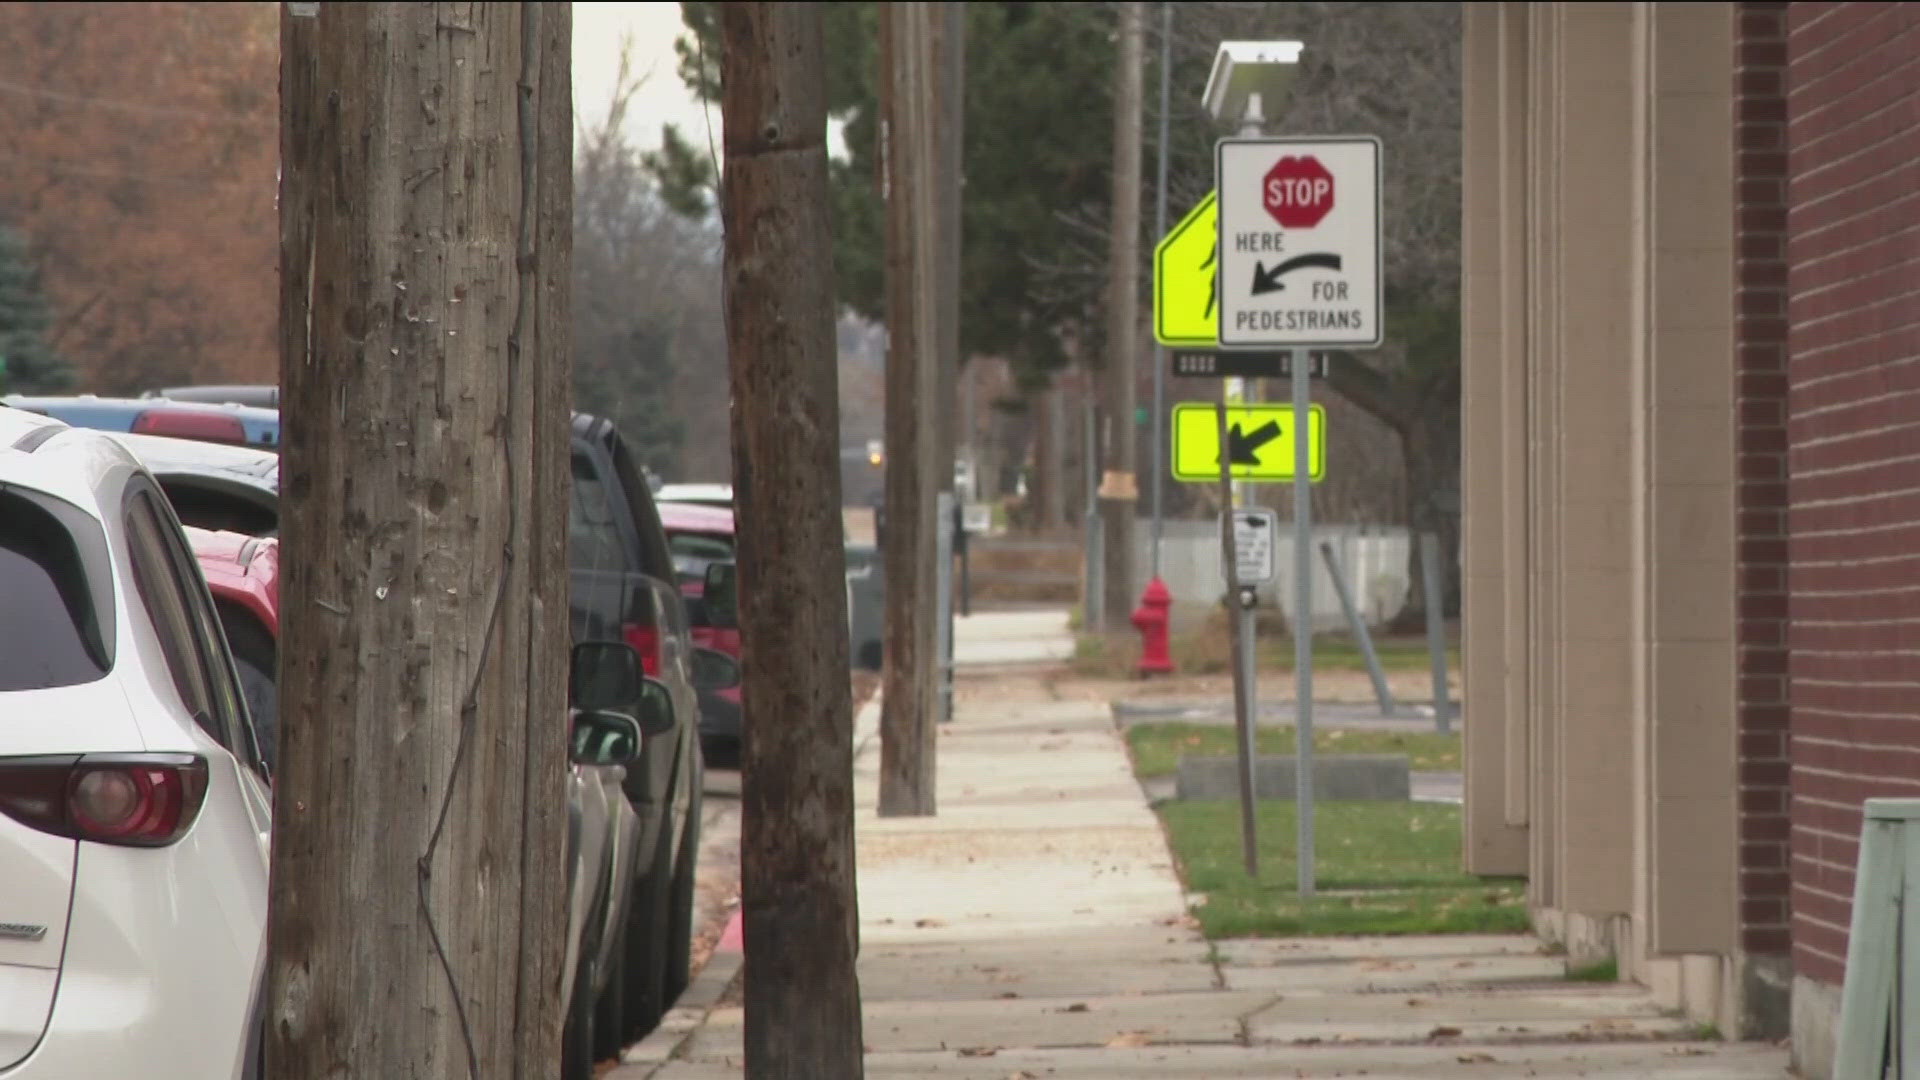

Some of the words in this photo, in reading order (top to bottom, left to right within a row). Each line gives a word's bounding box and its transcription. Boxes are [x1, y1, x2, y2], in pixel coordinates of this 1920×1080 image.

[1267, 178, 1330, 207] STOP
[1236, 232, 1284, 251] HERE
[1312, 281, 1349, 301] FOR
[1236, 309, 1362, 330] PEDESTRIANS
